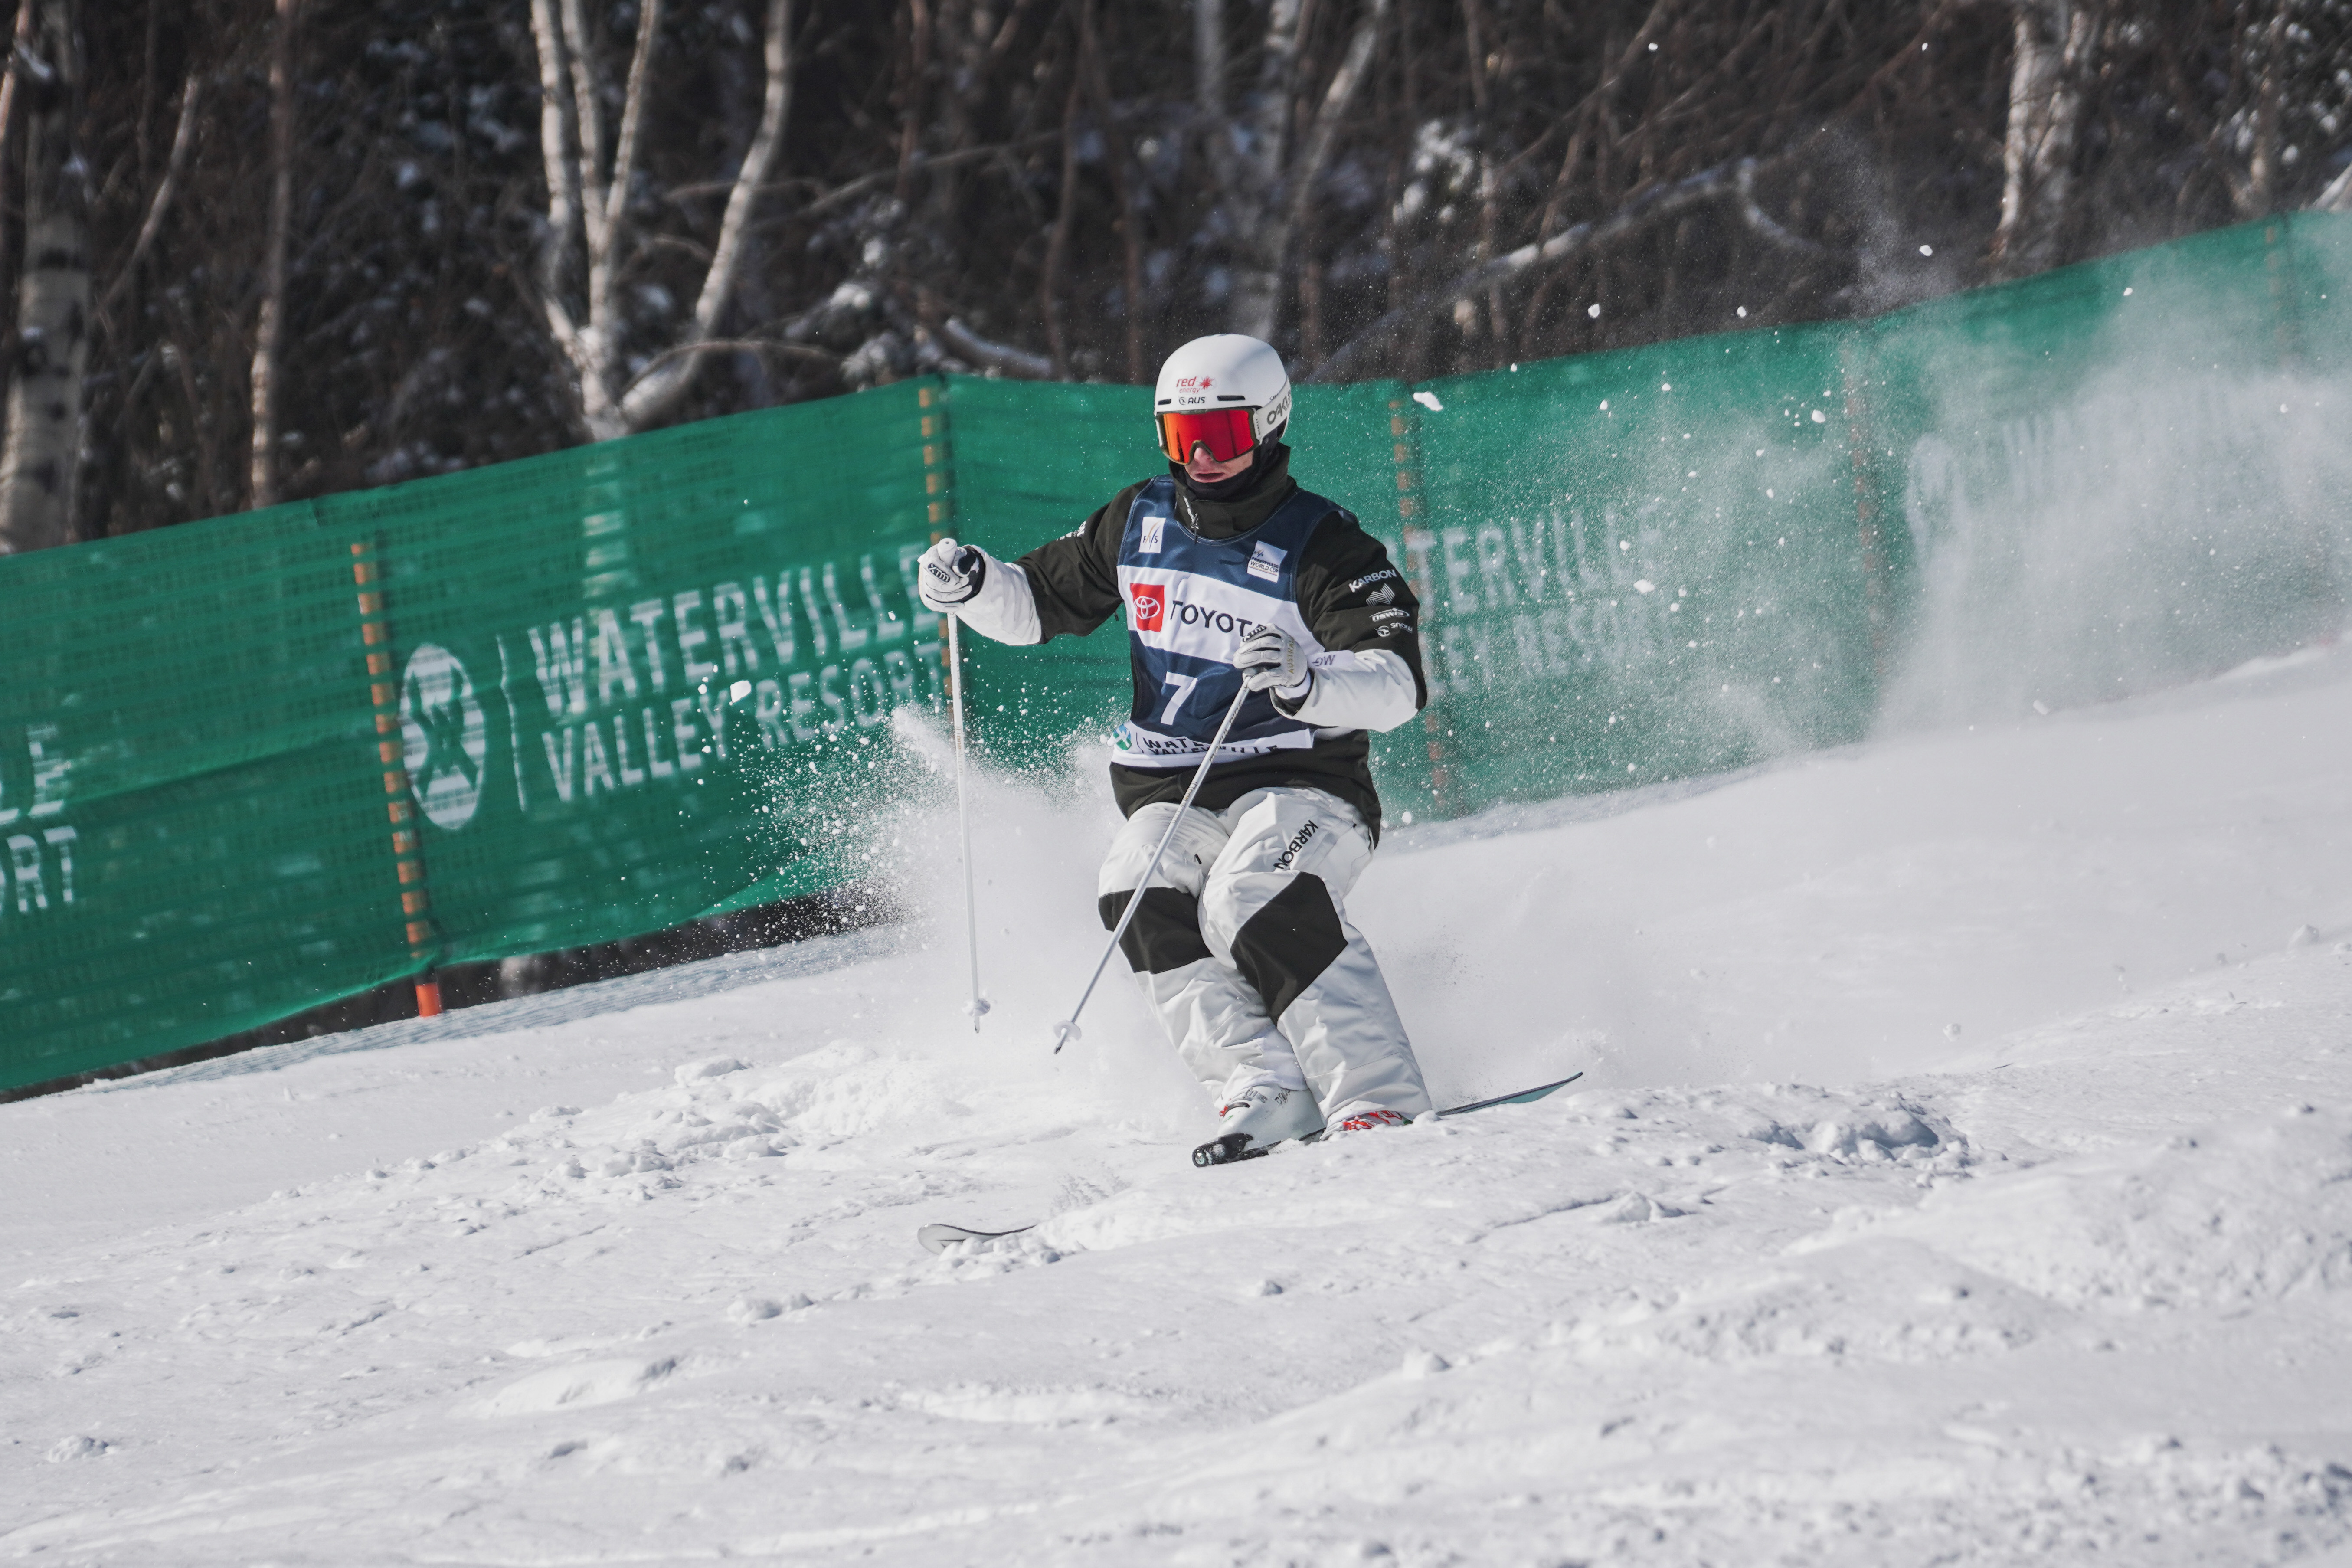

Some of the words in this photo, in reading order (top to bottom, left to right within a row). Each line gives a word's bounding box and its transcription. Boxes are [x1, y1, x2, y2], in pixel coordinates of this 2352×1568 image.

[1176, 376, 1197, 387] red
[1250, 561, 1269, 570] WORLD
[1348, 569, 1397, 593] KARBON
[527, 541, 941, 719] WATERVILLE
[1170, 600, 1253, 638] TOYOT
[1160, 671, 1198, 725] 7
[541, 689, 727, 802] VALLEY
[755, 640, 942, 751] RESORT
[1273, 820, 1318, 869] KARBON
